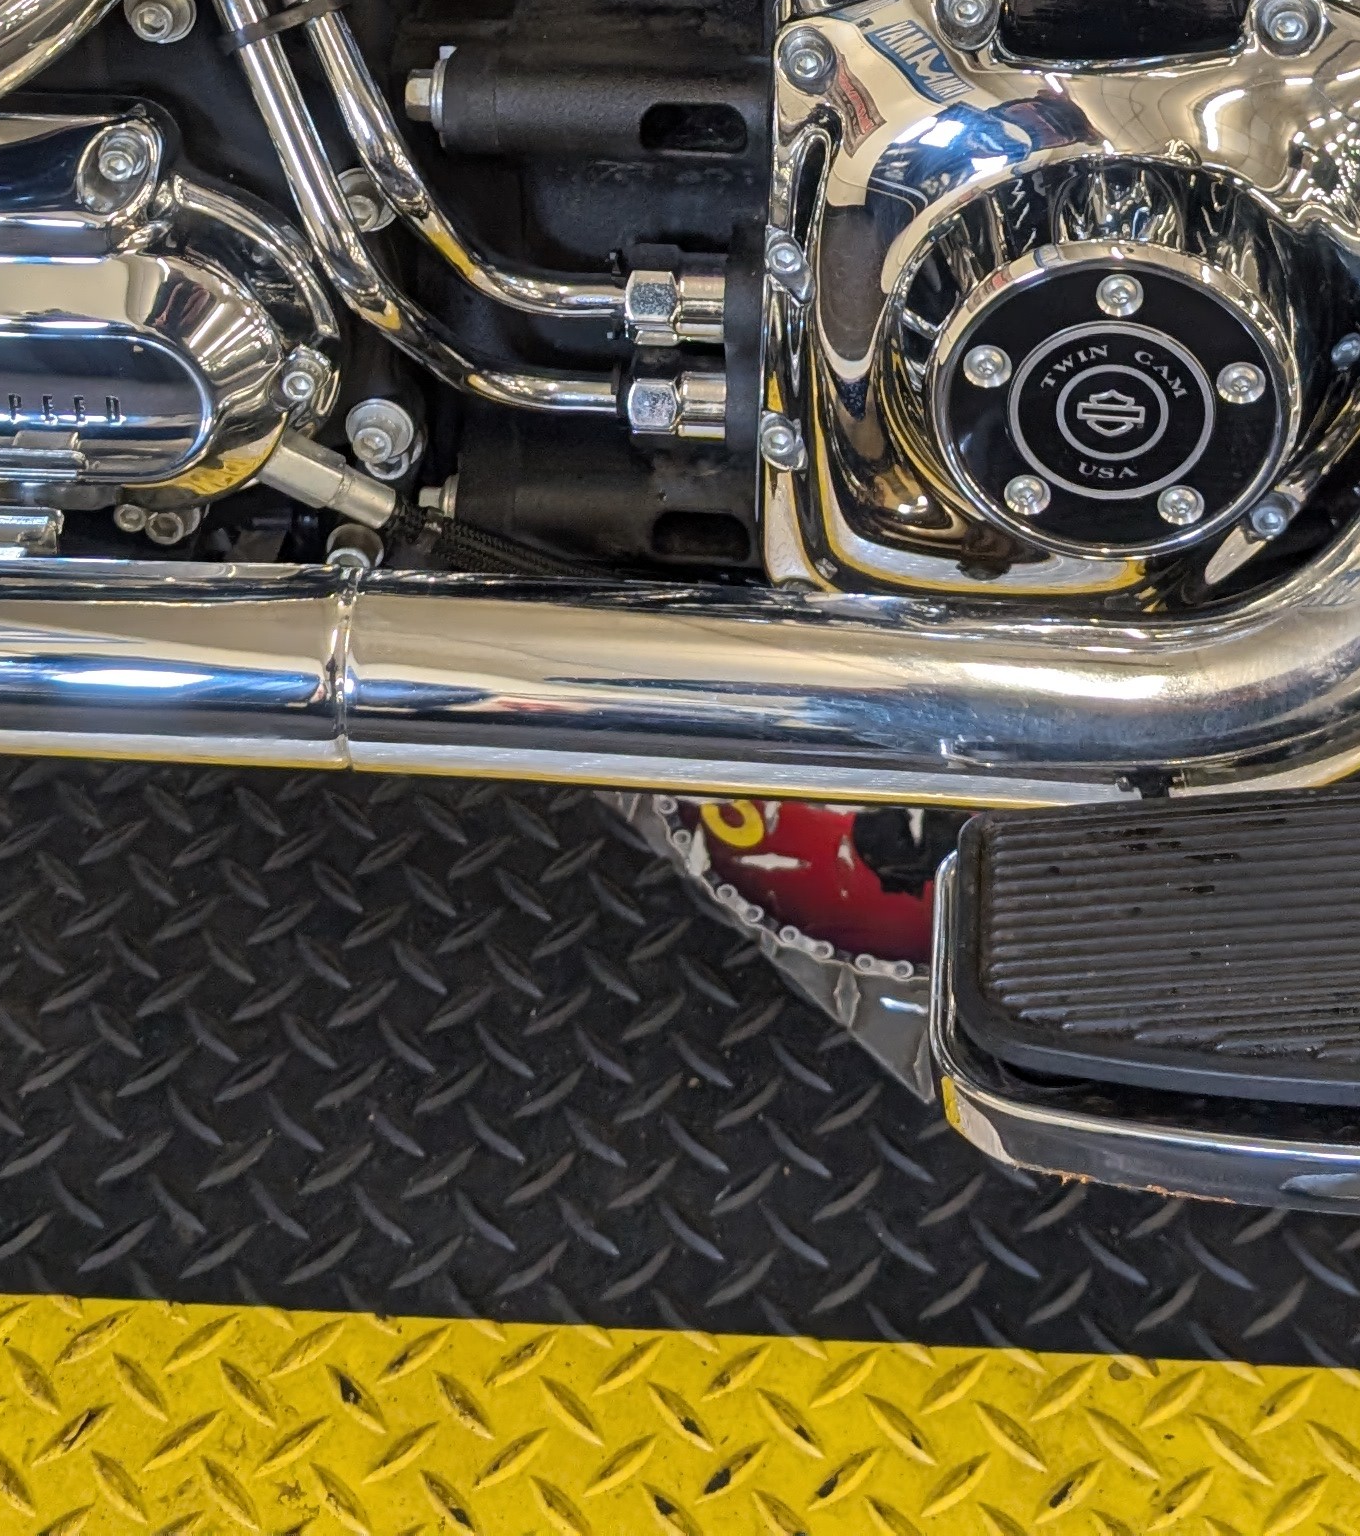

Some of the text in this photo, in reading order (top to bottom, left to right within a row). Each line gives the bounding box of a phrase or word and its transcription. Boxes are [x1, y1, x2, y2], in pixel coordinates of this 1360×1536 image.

[1040, 344, 1189, 400] TWIN CAM
[1078, 461, 1139, 480] USA
